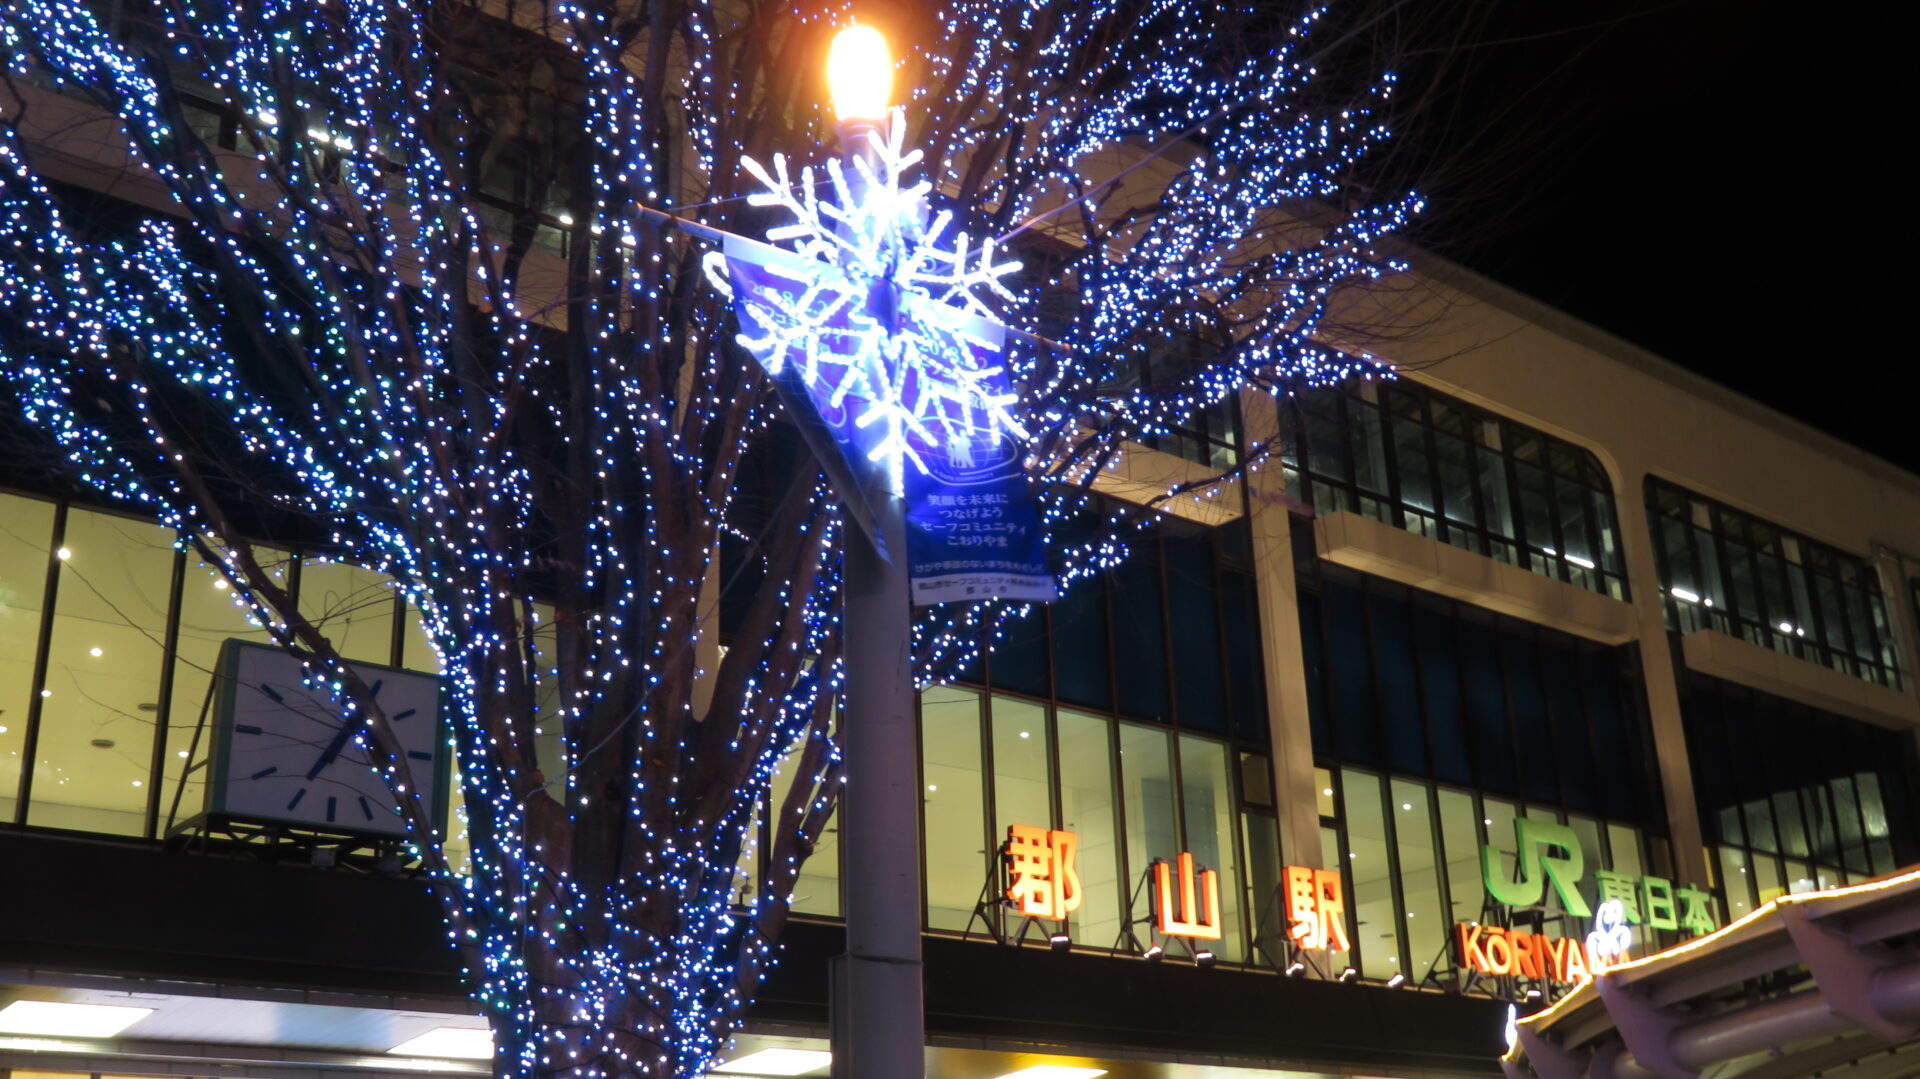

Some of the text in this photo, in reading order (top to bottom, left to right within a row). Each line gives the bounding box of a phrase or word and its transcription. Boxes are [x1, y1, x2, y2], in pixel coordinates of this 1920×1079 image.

[939, 507, 1004, 519] つなげよう
[920, 520, 1027, 536] セーフコミュニティ
[946, 535, 1009, 547] こおりやま
[1483, 817, 1716, 936] JR 東日本
[1005, 823, 1351, 952] 郡山駅
